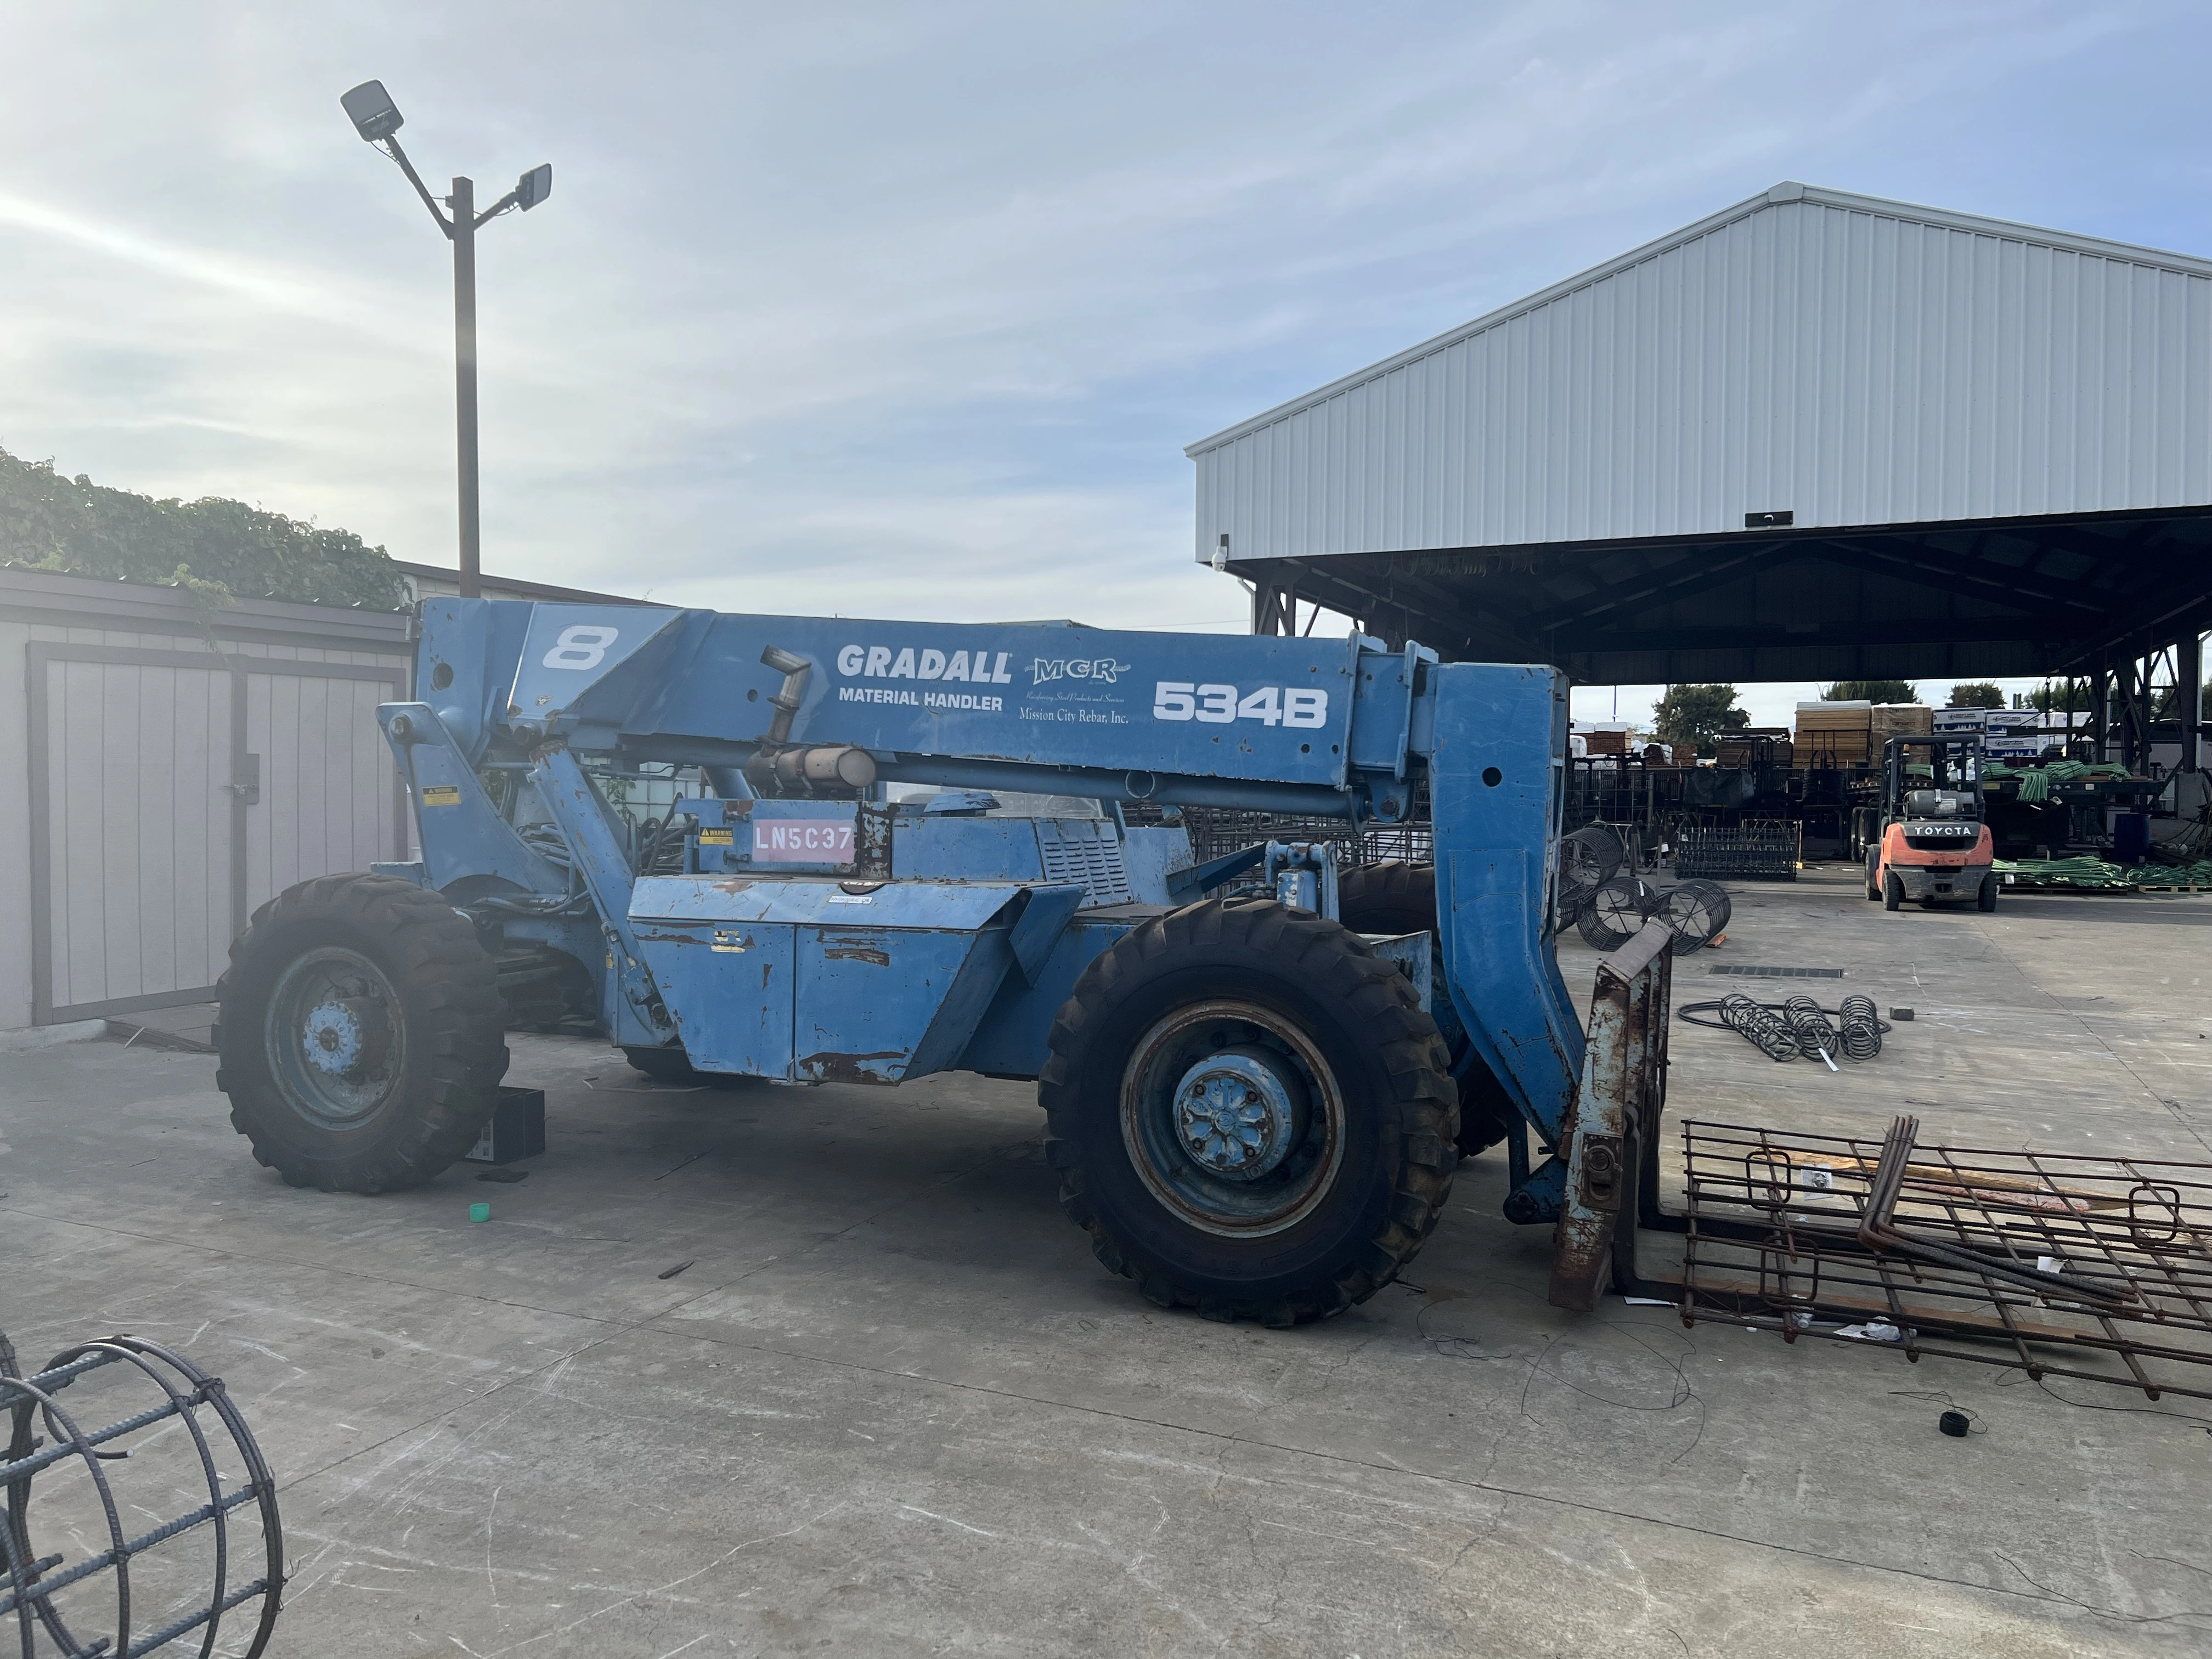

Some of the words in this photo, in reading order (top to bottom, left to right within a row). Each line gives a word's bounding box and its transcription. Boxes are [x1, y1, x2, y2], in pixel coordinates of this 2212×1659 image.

[543, 625, 619, 670] 8
[838, 645, 1012, 684] GRADALL
[1033, 658, 1117, 685] MCR
[839, 687, 919, 706] MATERIAL
[924, 692, 1002, 711] HANDLER
[1153, 681, 1328, 729] 534B
[1019, 707, 1054, 721] Mission
[1057, 709, 1076, 724] City
[1079, 709, 1107, 724] Rebar,
[1111, 710, 1128, 724] Inc.
[756, 827, 851, 850] LN5C37
[1915, 827, 1971, 835] TOYOTA
